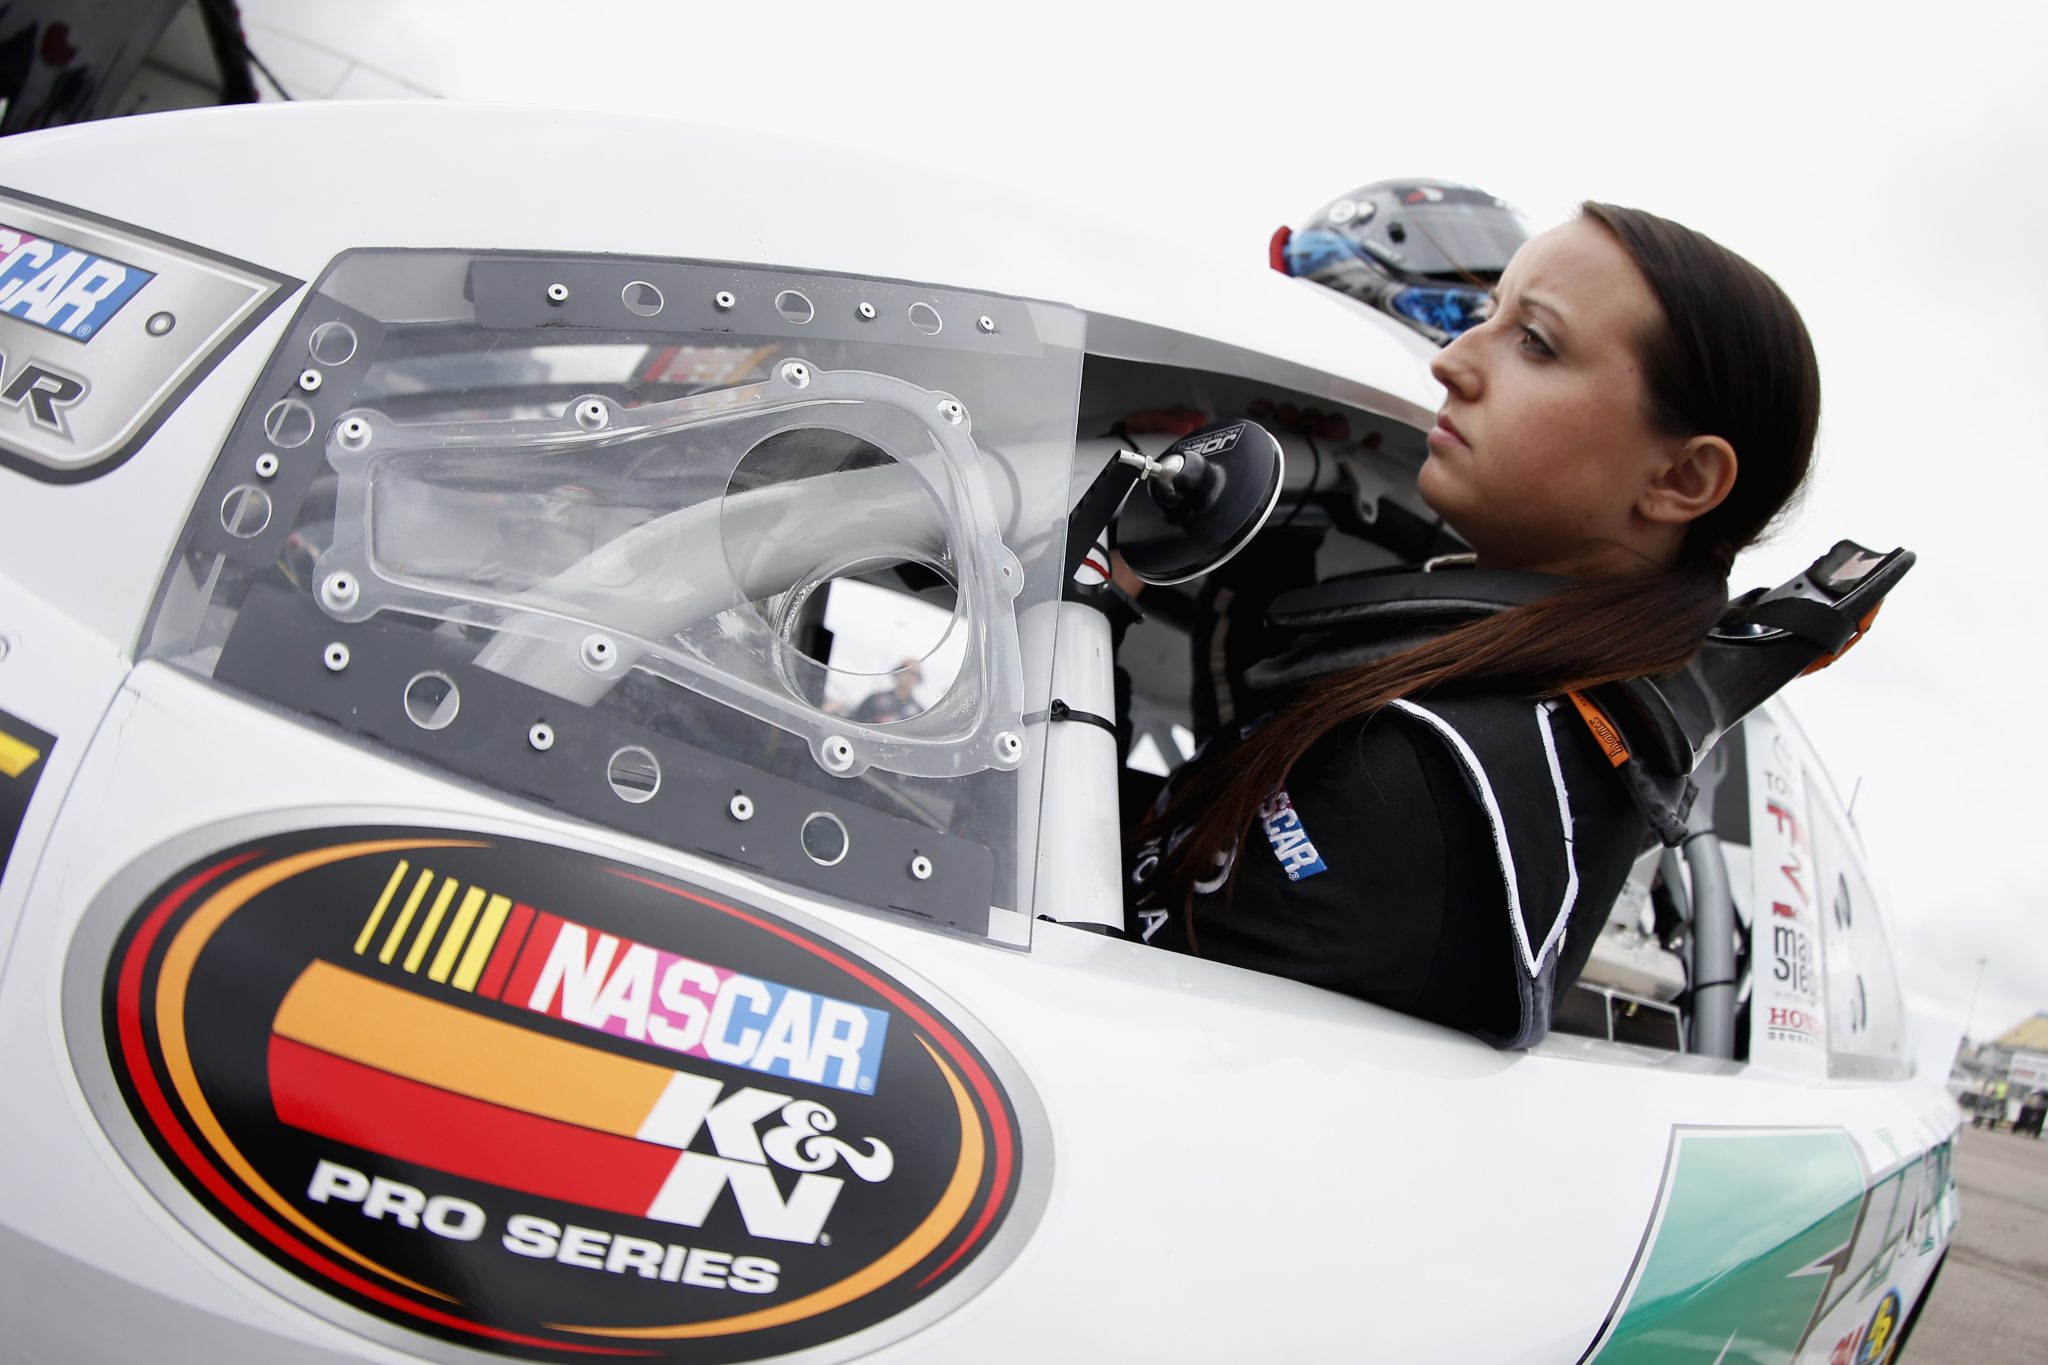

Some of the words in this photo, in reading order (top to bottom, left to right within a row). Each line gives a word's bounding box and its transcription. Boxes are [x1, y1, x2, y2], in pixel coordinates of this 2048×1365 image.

[528, 921, 869, 1090] NASCAR
[307, 1159, 487, 1241] PRO
[503, 1214, 781, 1294] SERIES
